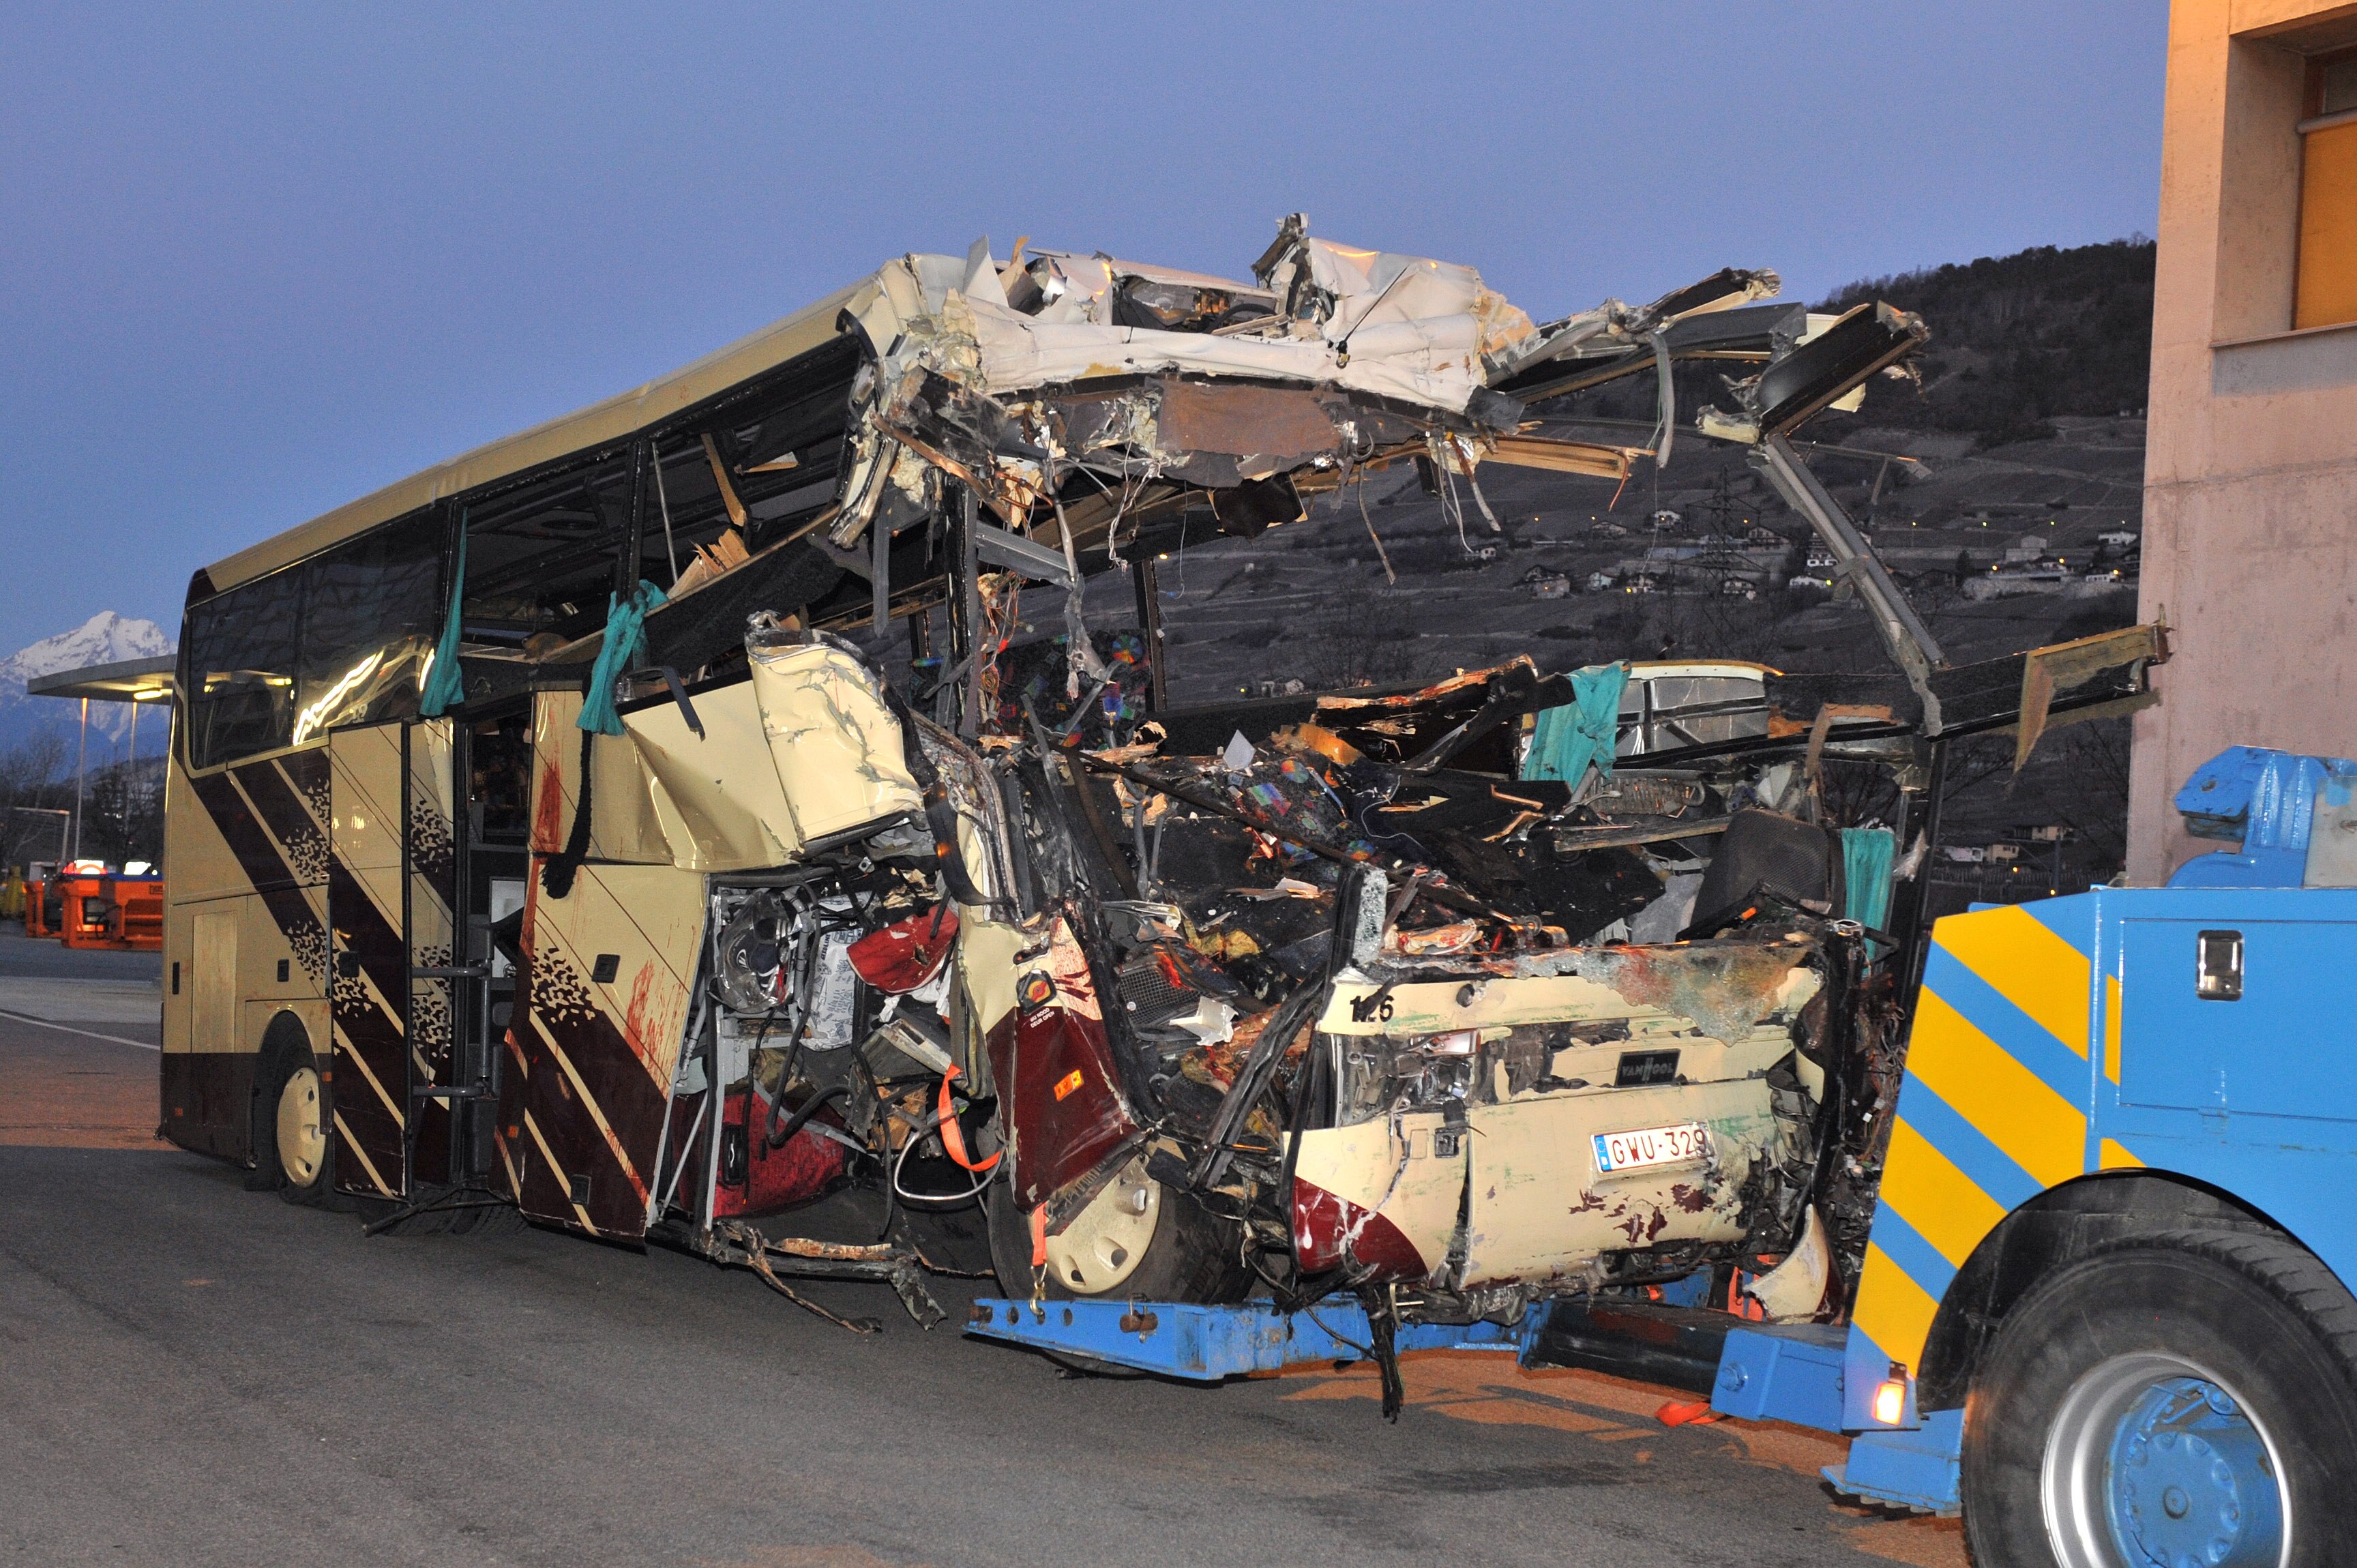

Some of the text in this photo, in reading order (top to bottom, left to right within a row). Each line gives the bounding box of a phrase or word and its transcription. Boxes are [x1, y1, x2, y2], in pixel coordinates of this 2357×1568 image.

[1037, 1007, 1050, 1018] NOOD
[1030, 1011, 1055, 1029] DEUR OPEN
